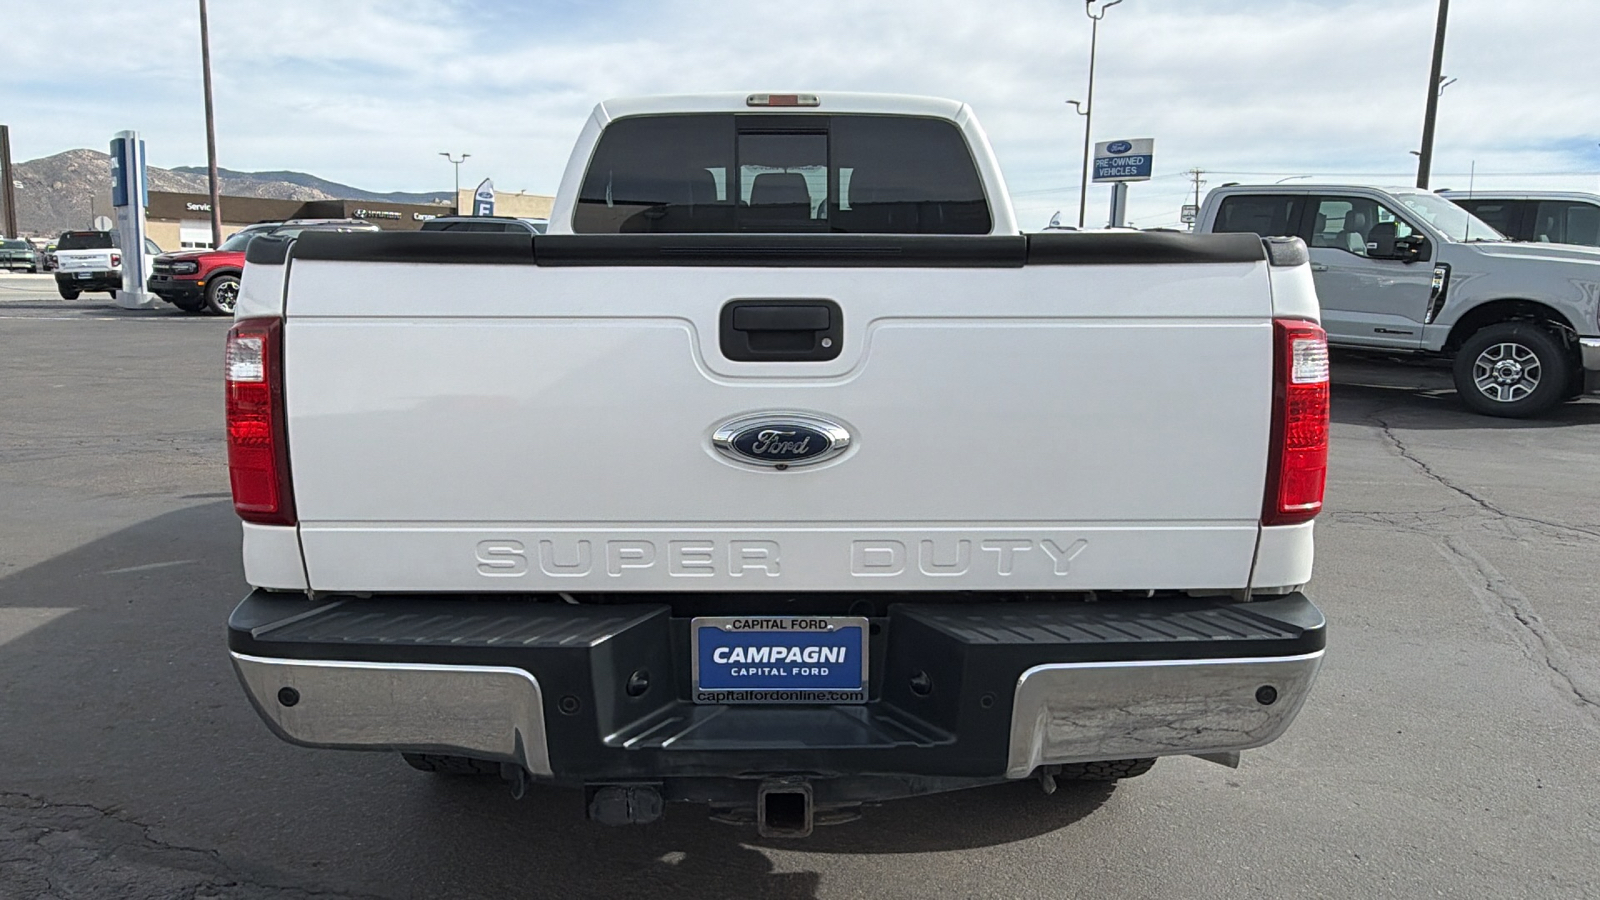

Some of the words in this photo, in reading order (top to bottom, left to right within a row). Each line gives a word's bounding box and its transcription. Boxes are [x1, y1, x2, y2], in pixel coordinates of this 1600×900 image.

[1096, 157, 1144, 168] PRE-OWNED
[1099, 166, 1137, 176] VEHICLES
[186, 202, 212, 212] Servic
[752, 429, 811, 454] Ford
[476, 539, 781, 577] SUPER
[850, 538, 1088, 577] DUTY
[732, 619, 786, 630] CAPITAL
[791, 619, 828, 630] FORD
[713, 647, 846, 664] CAMPAGNI
[731, 667, 787, 676] CAPITAL
[792, 667, 829, 676] FORD
[697, 690, 864, 703] capitalfordonline.com
